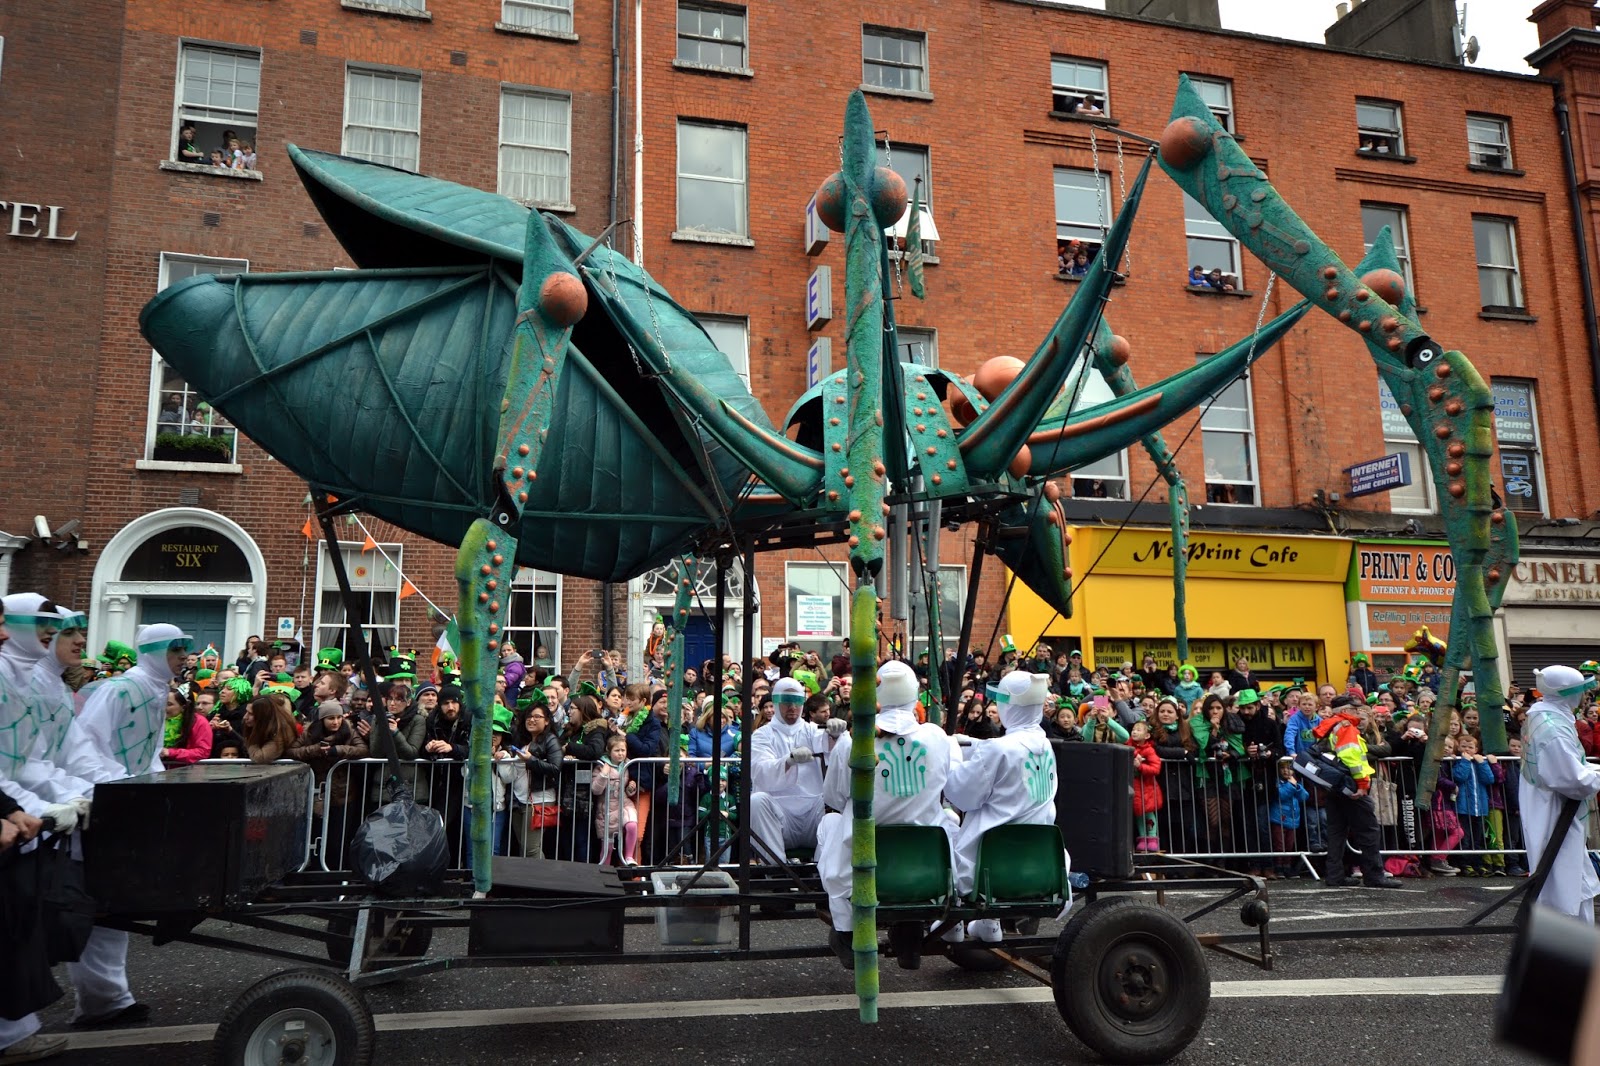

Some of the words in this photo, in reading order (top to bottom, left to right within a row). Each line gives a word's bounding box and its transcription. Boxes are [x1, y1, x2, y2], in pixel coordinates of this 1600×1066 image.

[0, 201, 78, 240] EL
[1380, 388, 1393, 397] La
[1493, 396, 1514, 405] Lan
[1518, 397, 1527, 406] &
[1382, 411, 1407, 421] Ga
[1494, 408, 1529, 418] Online
[1495, 418, 1531, 429] Game
[1496, 430, 1533, 440] Centre
[1351, 457, 1397, 477] INTERNET
[1352, 482, 1371, 492] GAME
[1373, 476, 1399, 487] CENTRE
[161, 544, 218, 553] RESTAURANT
[1133, 540, 1174, 562] Ne
[1187, 542, 1242, 562] Print
[1250, 545, 1298, 567] Cafe
[175, 553, 202, 567] SIX
[1360, 551, 1411, 580] PRINT
[1415, 553, 1427, 581] &
[1432, 553, 1457, 582] CO
[1370, 585, 1409, 594] INTERNET
[1411, 587, 1417, 595] &
[1418, 586, 1444, 595] PHONE
[1373, 610, 1406, 625] Refilling
[1409, 611, 1421, 622] Ink
[1095, 655, 1125, 664] BURNING
[1194, 655, 1210, 663] COPY
[1231, 645, 1267, 664] SCAN
[1281, 646, 1305, 662] FAX
